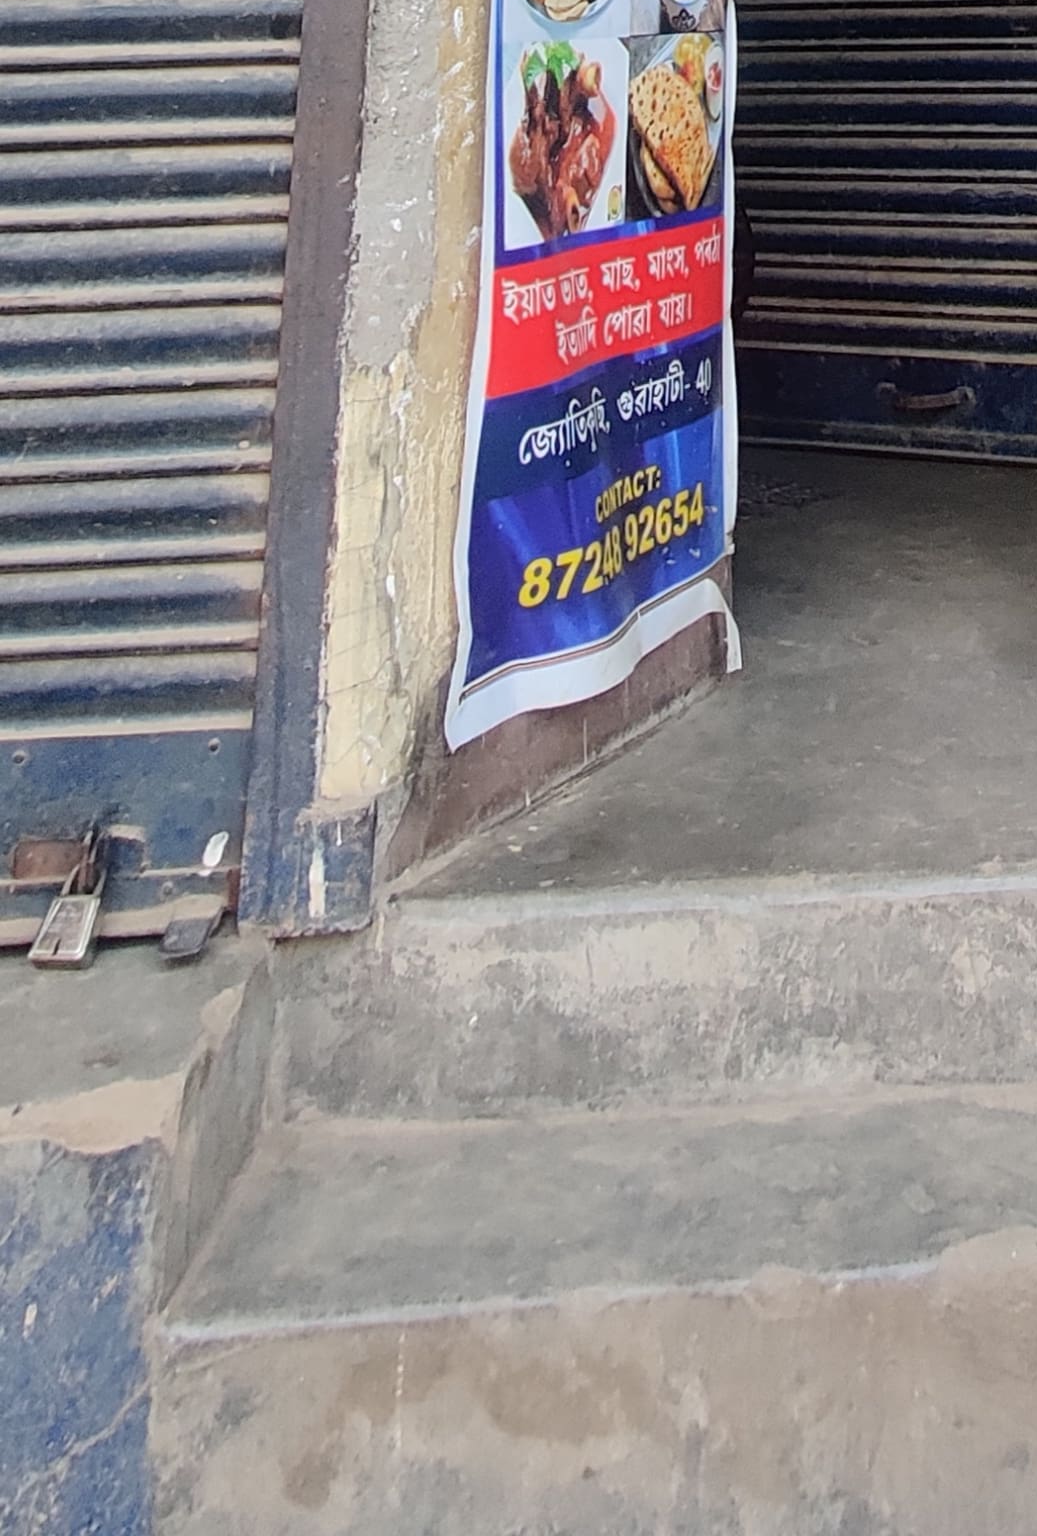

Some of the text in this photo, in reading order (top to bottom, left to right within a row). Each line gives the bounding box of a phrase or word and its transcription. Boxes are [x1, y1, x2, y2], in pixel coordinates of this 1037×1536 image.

[501, 277, 556, 325] ইয়াত
[559, 266, 594, 305] ভাত,
[600, 256, 641, 294] মাছ,
[648, 245, 690, 282] মাংস,
[603, 299, 652, 347] পোৱা
[595, 465, 662, 524] CONTACT:
[517, 482, 706, 609] 87248 92654
